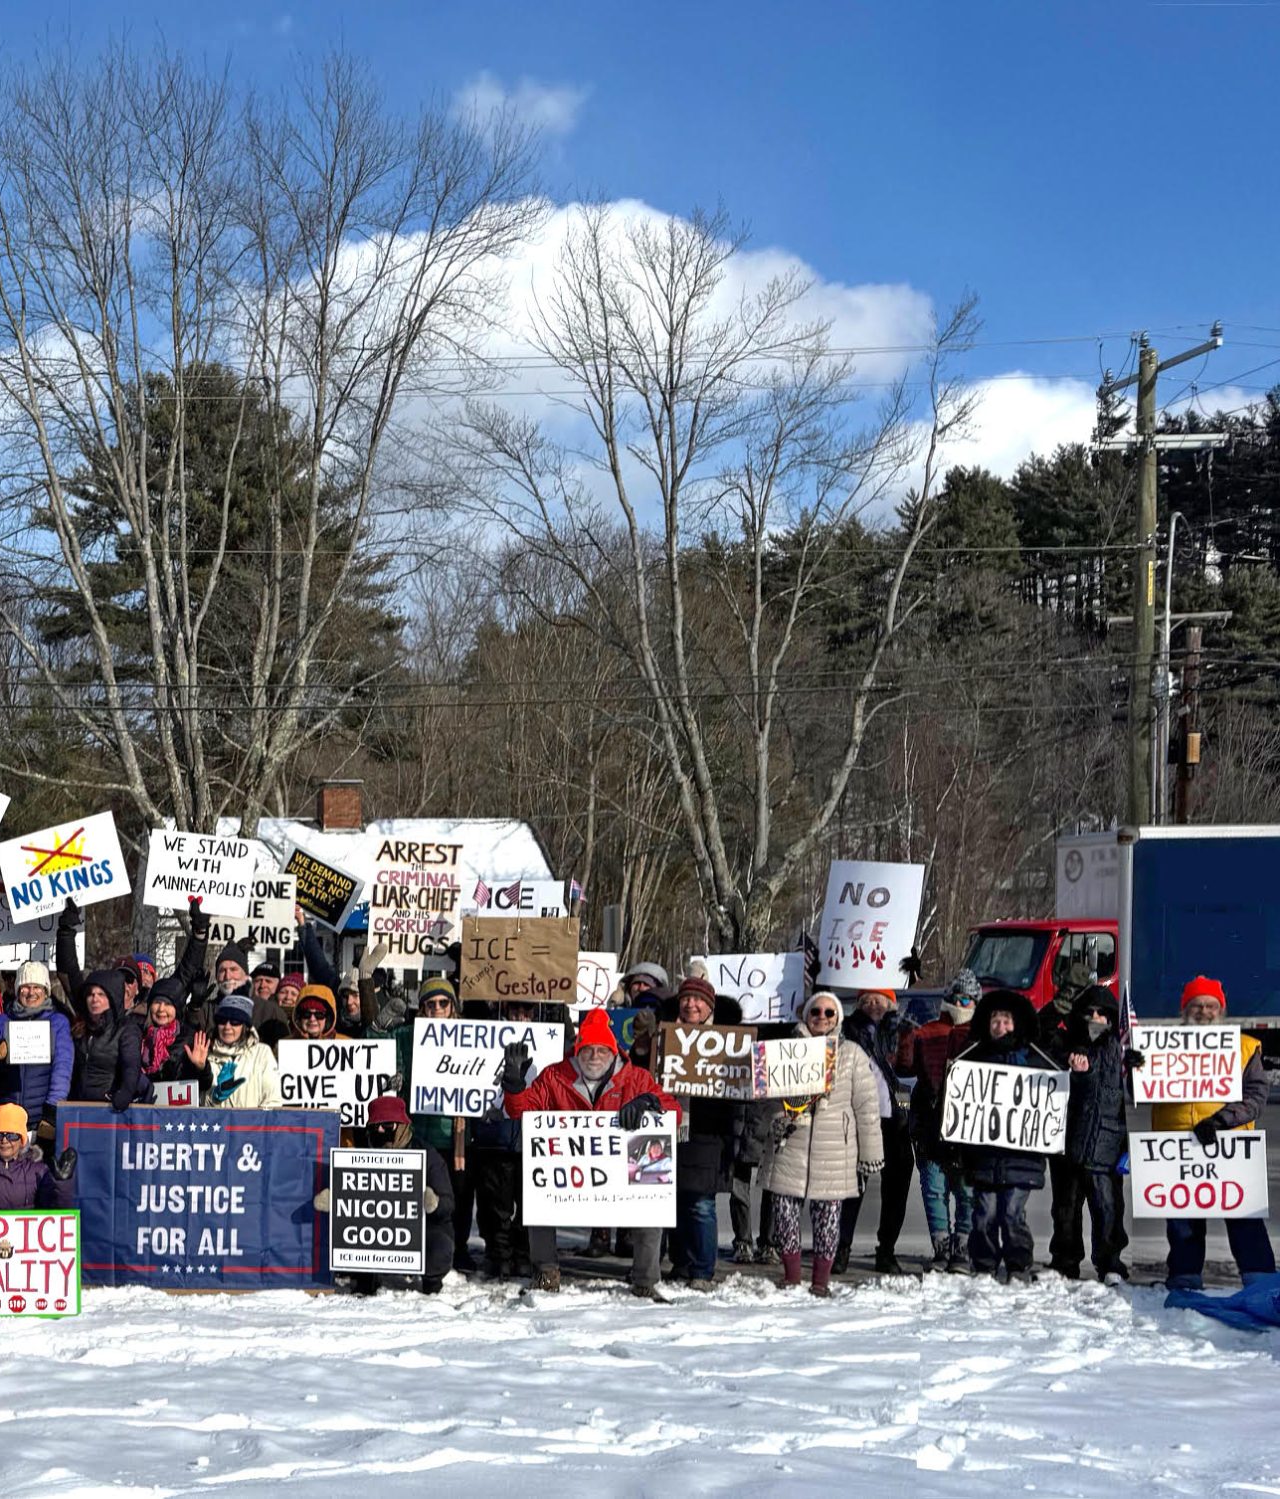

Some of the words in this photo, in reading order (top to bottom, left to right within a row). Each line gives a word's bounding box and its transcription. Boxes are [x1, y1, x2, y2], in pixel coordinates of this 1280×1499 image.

[164, 835, 187, 853] WE
[197, 838, 250, 859] STAND
[376, 840, 464, 866] ARREST
[178, 856, 222, 875] WITH
[294, 852, 311, 868] WE
[310, 861, 353, 891] DEMAND
[410, 862, 427, 872] THE
[10, 878, 44, 910] NO
[47, 859, 114, 898] KINGS
[151, 873, 248, 899] MINNEAPOLIS
[376, 870, 461, 888] CRIMINAL
[327, 883, 351, 903] NOT
[371, 884, 410, 909] LIAR
[418, 887, 462, 913] CHIEF
[485, 887, 535, 910] ICE
[838, 881, 891, 909] NO
[374, 917, 449, 934] CORRUPT
[391, 908, 411, 919] AND
[414, 910, 431, 920] HIS
[248, 925, 292, 945] KING
[826, 917, 889, 943] ICE
[372, 931, 451, 956] THUGS
[469, 936, 518, 961] ICE
[495, 969, 573, 999] Gestapo
[719, 955, 767, 989] NO
[419, 1022, 538, 1052] AMERICA
[674, 1027, 753, 1058] YOU
[1138, 1029, 1235, 1051] JUSTICE
[307, 1043, 379, 1072] DON'T
[778, 1041, 808, 1061] NO
[1150, 1050, 1237, 1077] EPSTEIN
[435, 1053, 487, 1076] Built
[663, 1054, 687, 1076] R
[694, 1057, 751, 1079] from
[768, 1060, 825, 1089] KINGS!
[280, 1073, 338, 1101] GIVE
[354, 1073, 392, 1103] UP
[948, 1067, 1009, 1106] SAVE
[1012, 1071, 1061, 1112] OUR
[1141, 1077, 1234, 1100] VICTIMS
[533, 1114, 621, 1129] JUSTICE
[945, 1101, 1065, 1148] DEMOCRACY
[121, 1141, 226, 1172] LIBERTY
[237, 1143, 263, 1172] &
[530, 1135, 622, 1158] RENEE
[1139, 1137, 1194, 1163] ICE
[1200, 1135, 1262, 1162] OUT
[351, 1155, 385, 1165] JUSTICE
[386, 1156, 405, 1165] FOR
[1178, 1162, 1219, 1181] FOR
[341, 1171, 414, 1193] RENEE
[531, 1165, 609, 1189] GOOD
[136, 1184, 246, 1215] JUSTICE
[1143, 1180, 1245, 1211] GOOD
[336, 1198, 419, 1219] NICOLE
[14, 1215, 76, 1254] ICE
[136, 1225, 187, 1256] FOR
[197, 1227, 244, 1256] ALL
[342, 1225, 412, 1247] GOOD
[339, 1253, 354, 1261] ICE
[355, 1253, 370, 1262] out
[372, 1253, 387, 1263] for
[387, 1255, 415, 1264] GOOD
[8, 1299, 27, 1309] STOP
